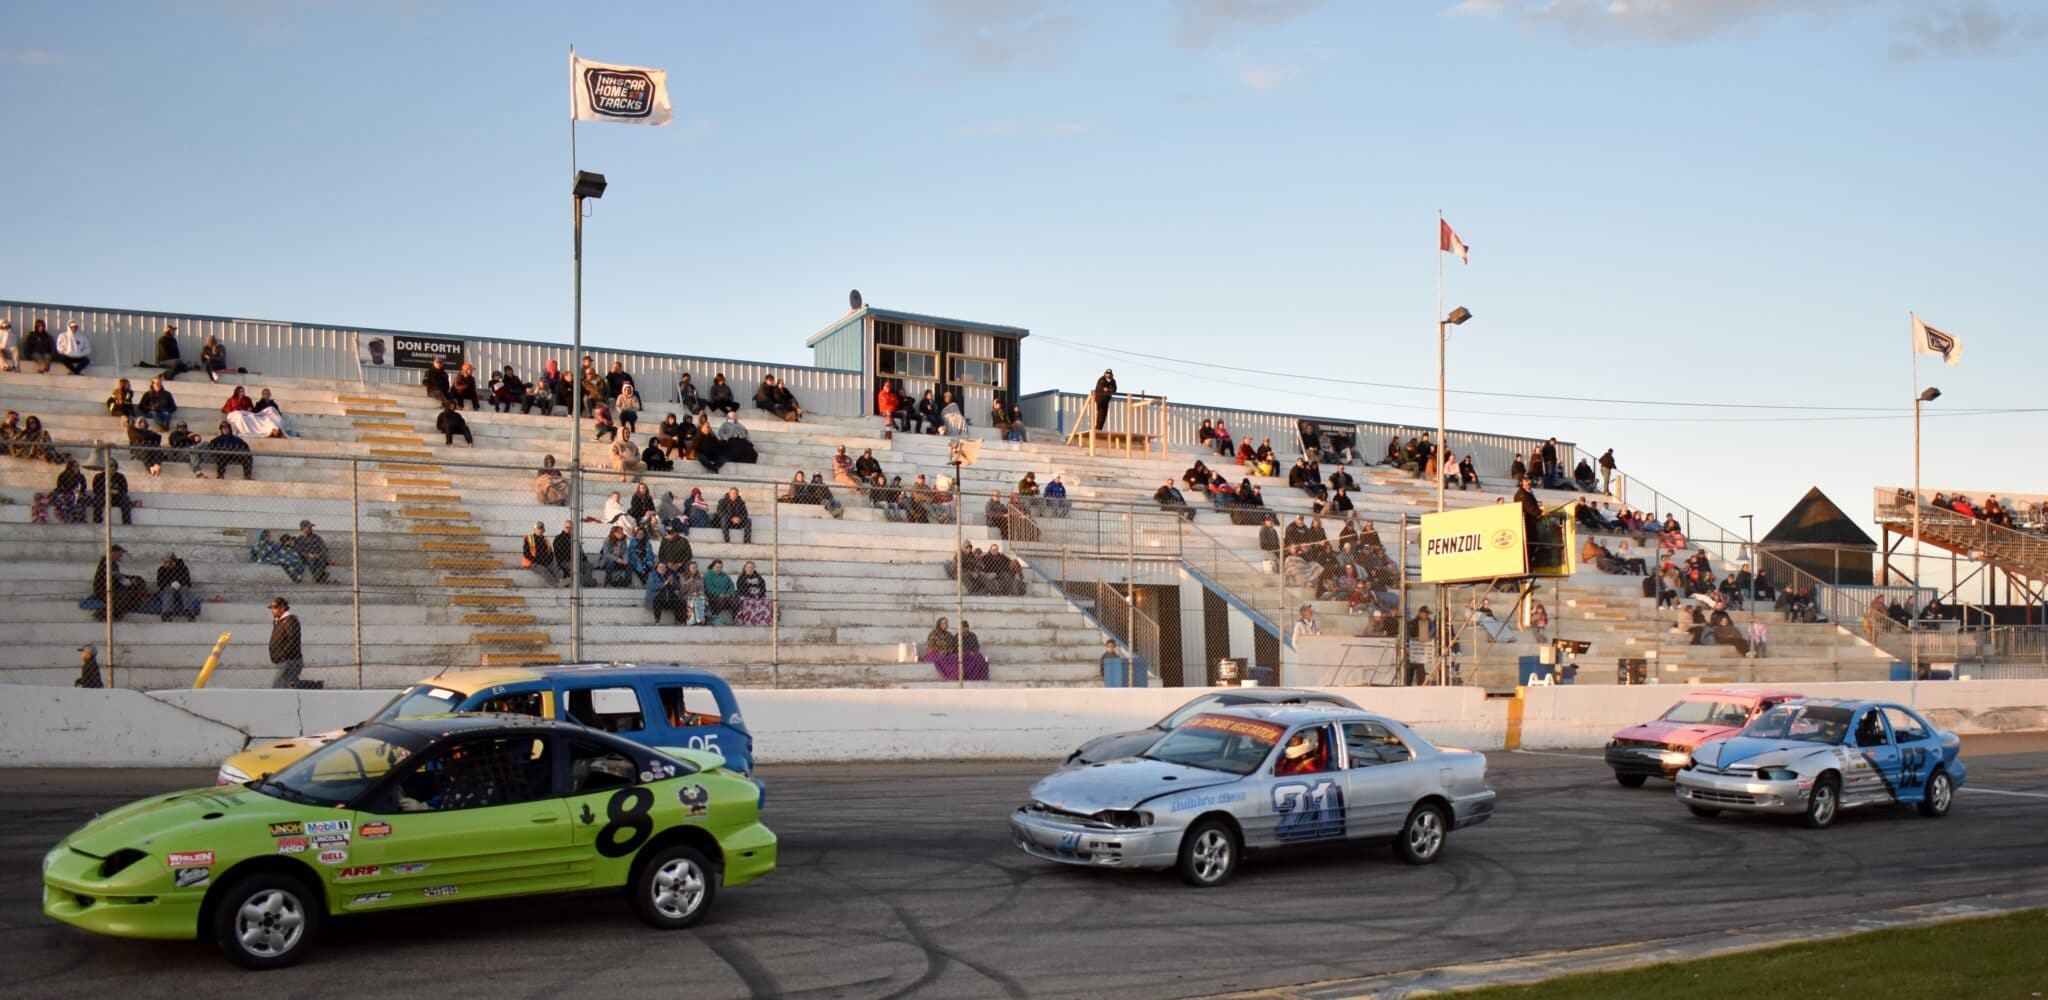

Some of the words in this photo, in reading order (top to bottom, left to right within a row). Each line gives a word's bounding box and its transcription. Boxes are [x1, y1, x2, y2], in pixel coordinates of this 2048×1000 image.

[595, 84, 629, 97] HOME
[599, 97, 642, 110] TRACKS
[397, 341, 421, 352] DON
[424, 343, 461, 354] FORTH
[1427, 534, 1482, 556] PENNZOIL
[1272, 779, 1345, 841] 21
[308, 822, 337, 833] Mobil
[595, 786, 654, 858] 8
[321, 852, 344, 861] BELL
[339, 865, 380, 878] ARP
